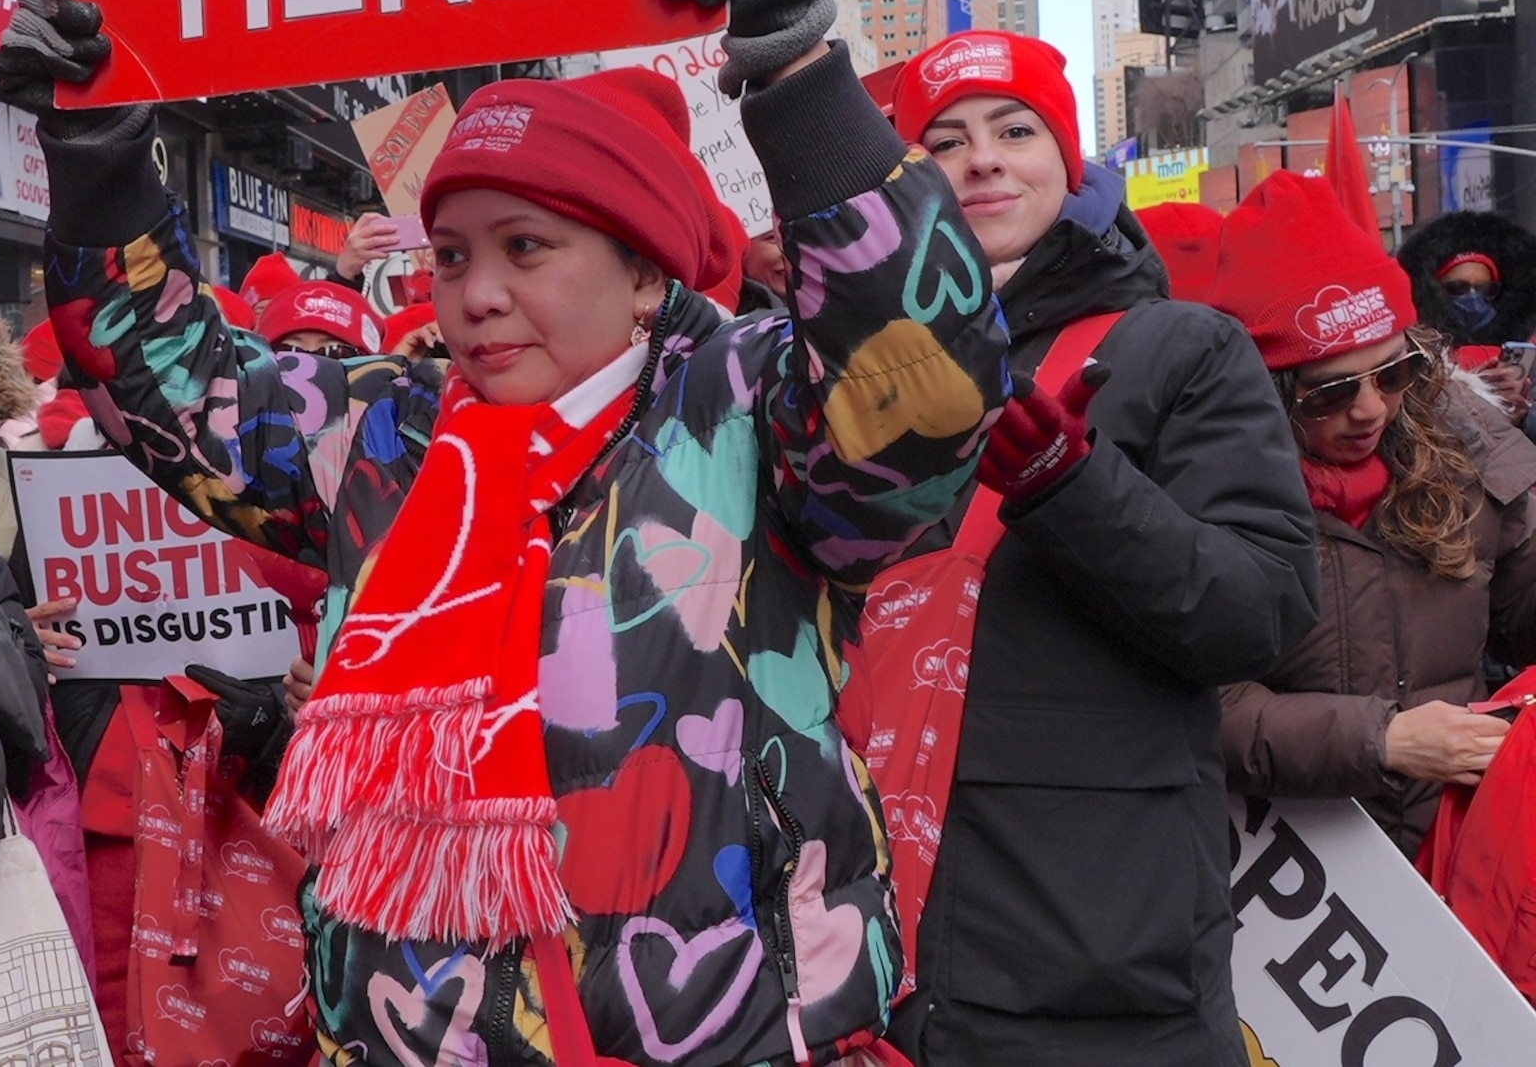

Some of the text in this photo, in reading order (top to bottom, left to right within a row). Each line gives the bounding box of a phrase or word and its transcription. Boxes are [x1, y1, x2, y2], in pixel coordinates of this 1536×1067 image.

[228, 166, 264, 214] BLUE
[1314, 293, 1385, 331] NURSES
[1318, 306, 1393, 339] ASSOCIATION
